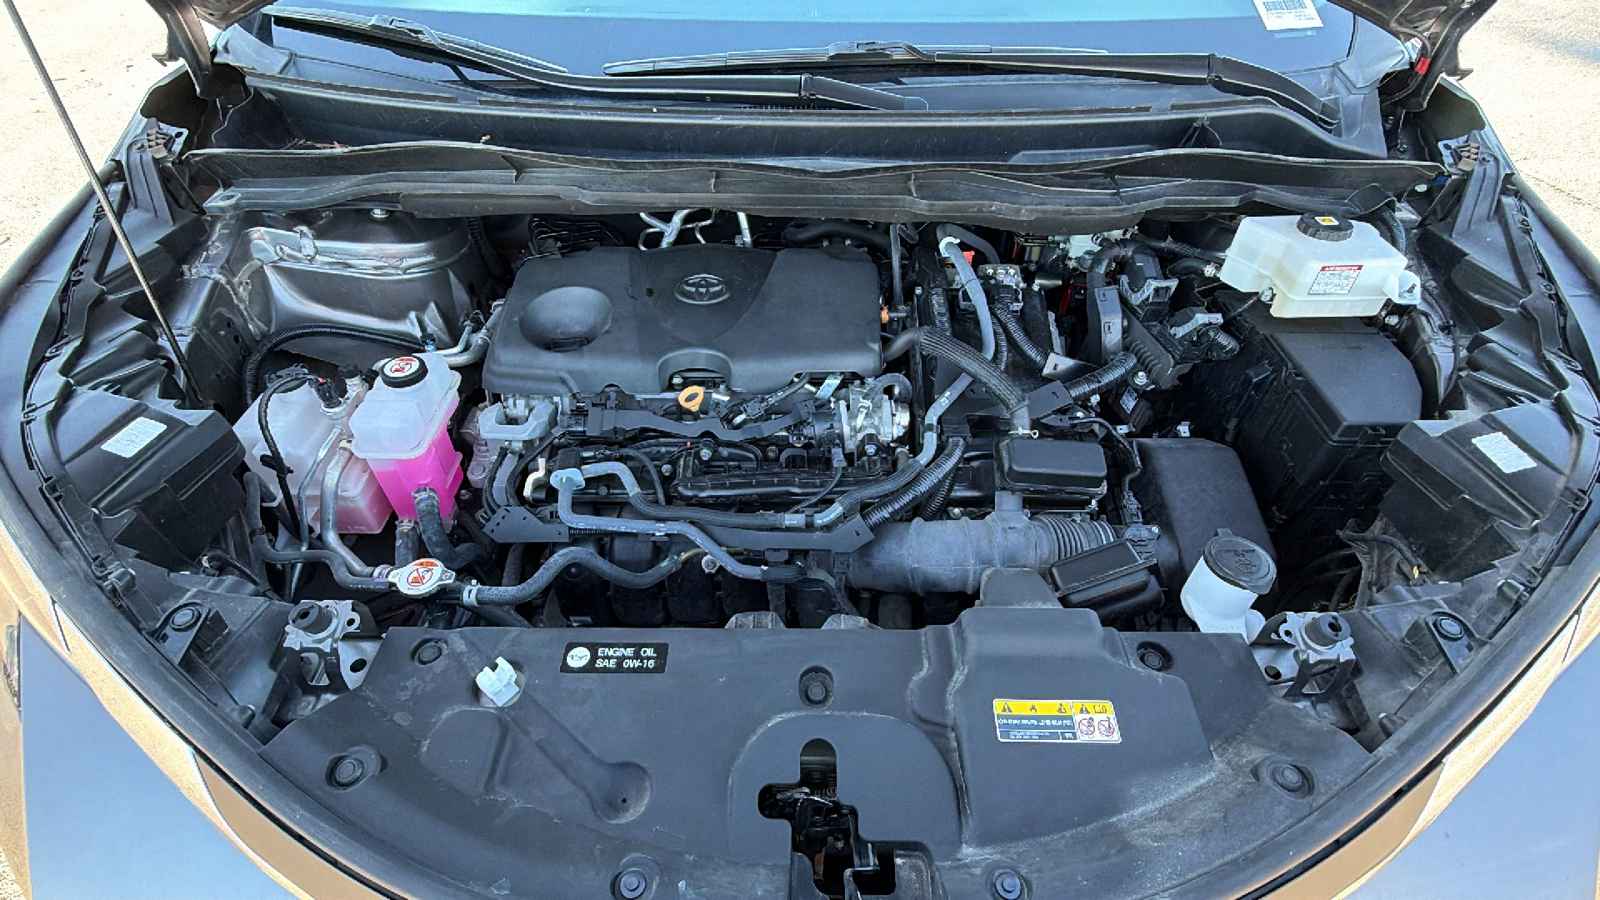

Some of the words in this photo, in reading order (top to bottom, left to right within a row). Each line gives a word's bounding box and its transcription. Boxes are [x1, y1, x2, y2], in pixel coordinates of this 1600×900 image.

[597, 647, 635, 657] ENGINE
[640, 647, 657, 657] OIL
[595, 658, 617, 668] SAE
[622, 659, 655, 669] 0W-16
